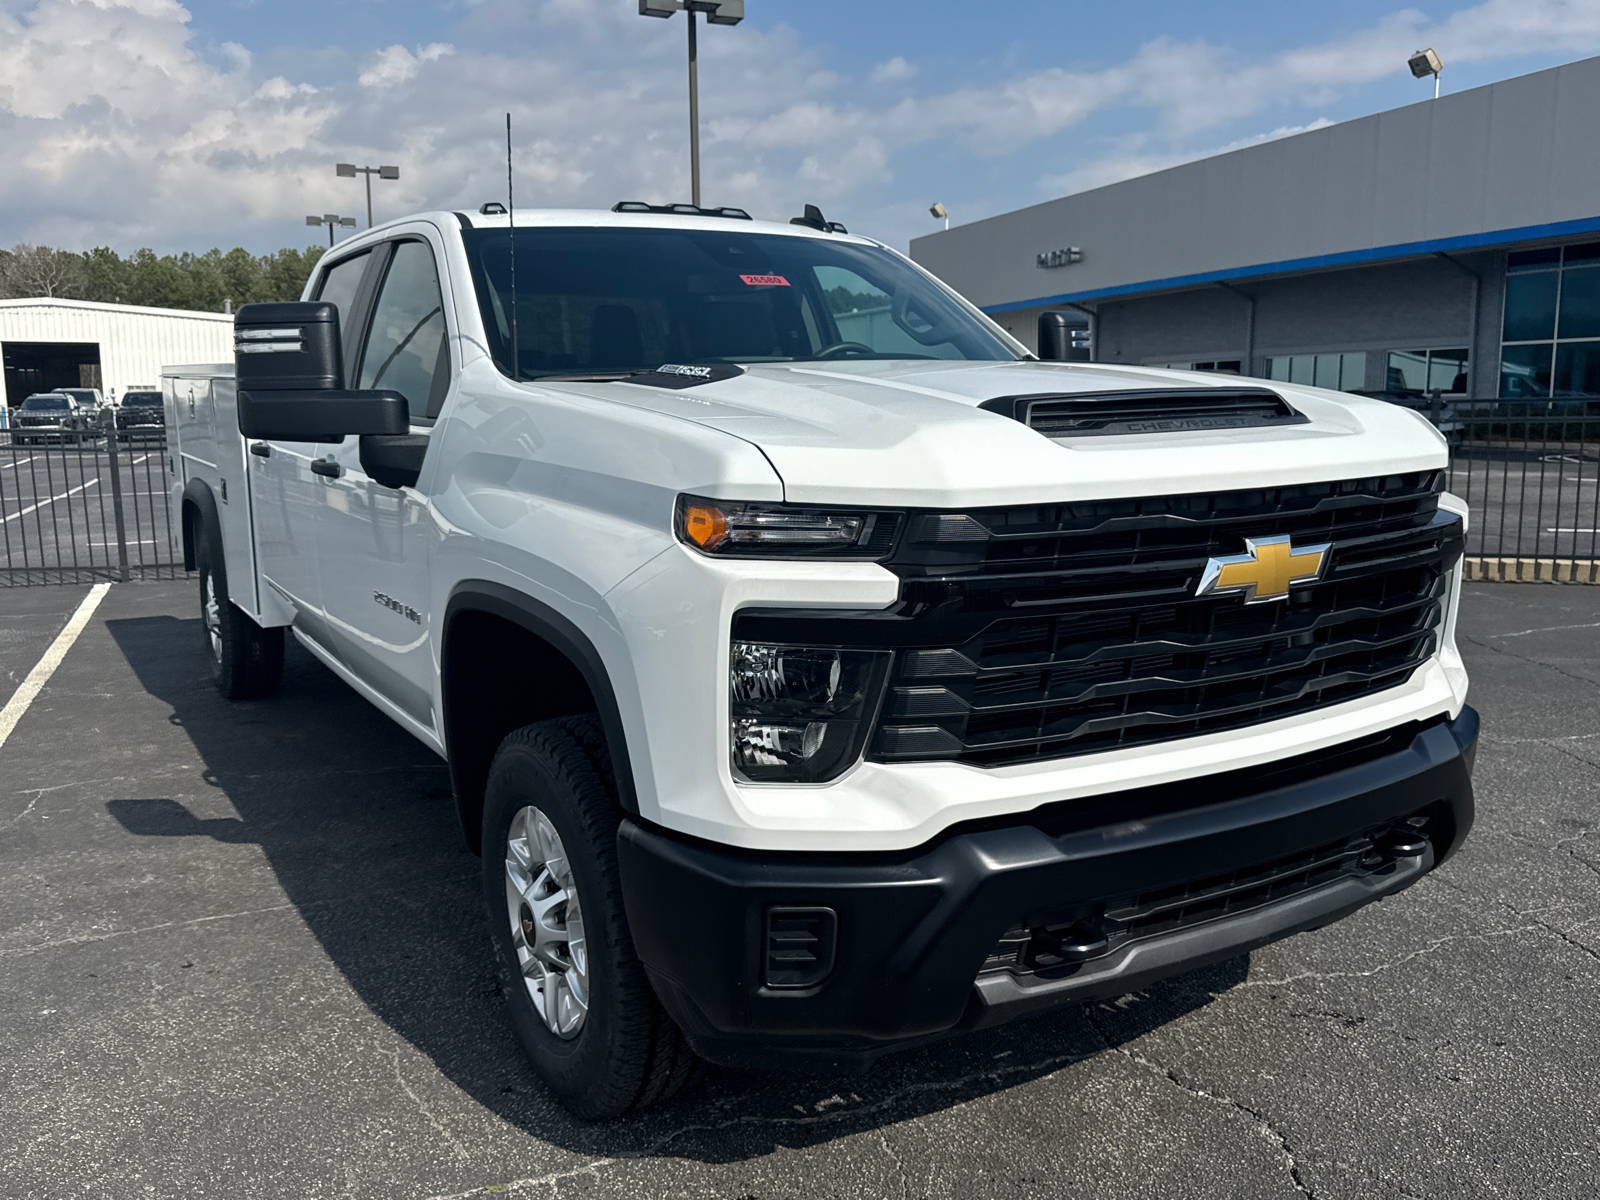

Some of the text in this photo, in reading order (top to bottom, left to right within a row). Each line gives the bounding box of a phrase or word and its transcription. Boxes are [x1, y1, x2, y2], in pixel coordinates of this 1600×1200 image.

[1036, 247, 1082, 268] PARTS
[746, 276, 782, 284] 26580
[1126, 418, 1246, 431] CHEVROLET
